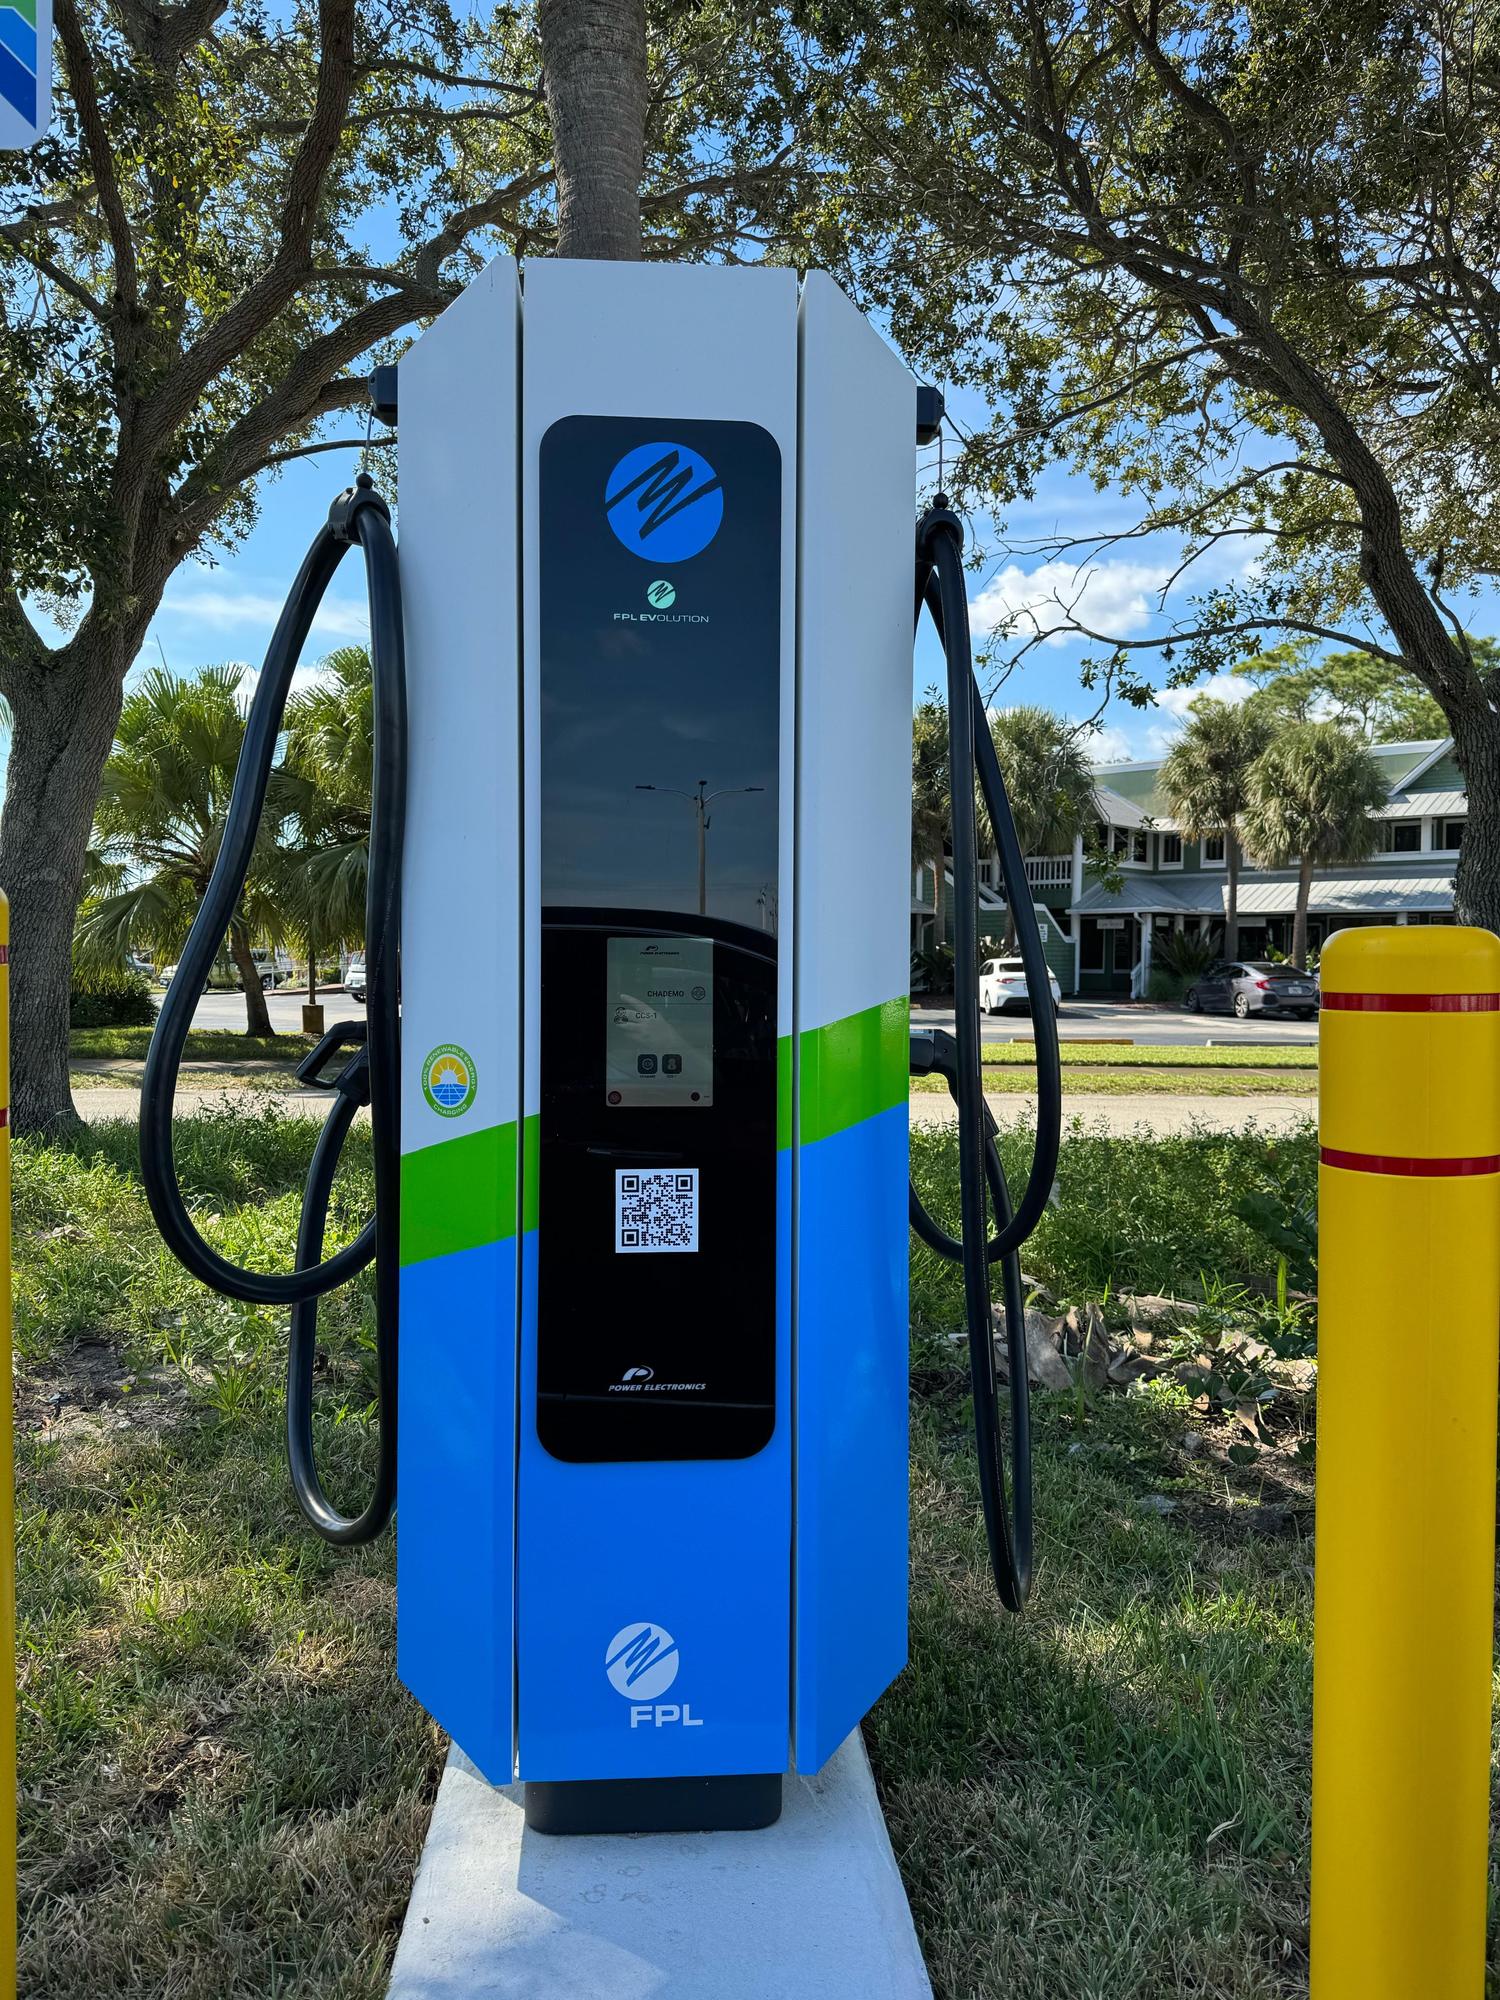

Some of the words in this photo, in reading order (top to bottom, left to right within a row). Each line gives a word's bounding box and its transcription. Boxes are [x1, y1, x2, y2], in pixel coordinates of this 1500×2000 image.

[613, 613, 637, 621] FPL
[640, 613, 709, 623] EVOLUTION
[647, 990, 684, 998] CHADEMO
[608, 1384, 642, 1392] POWER
[644, 1383, 706, 1391] ELECTRONICS
[630, 1704, 704, 1728] FPL
